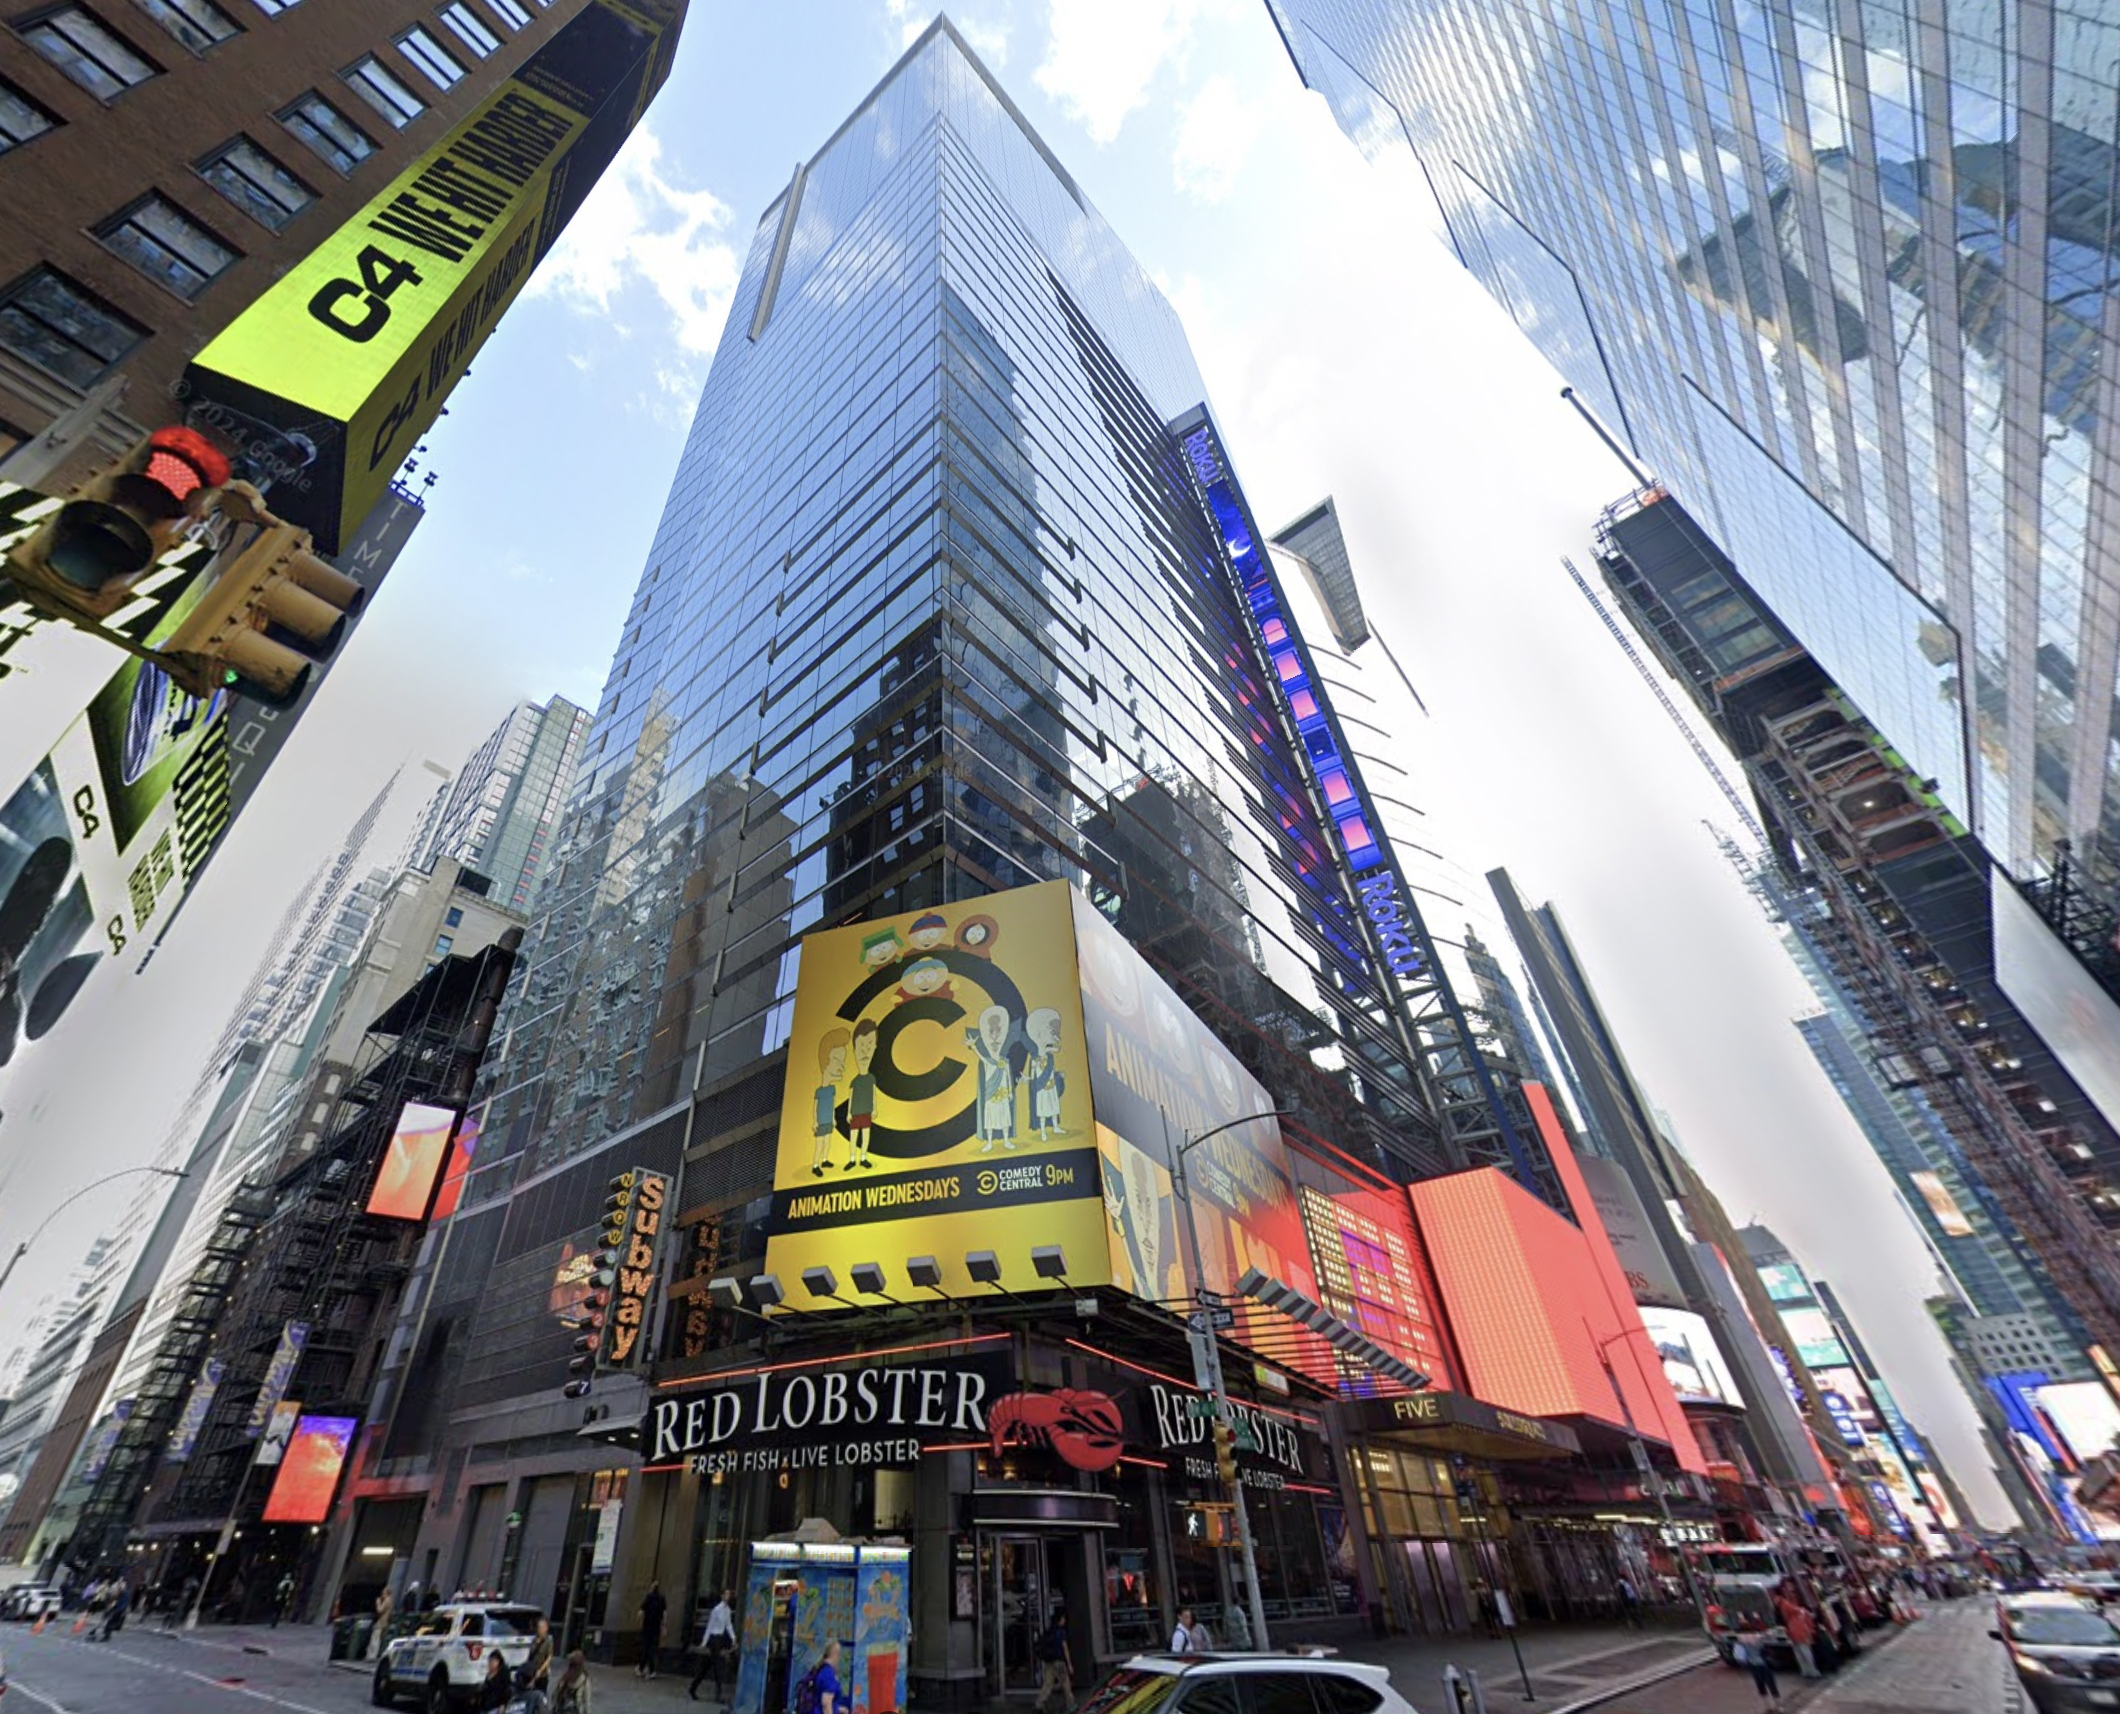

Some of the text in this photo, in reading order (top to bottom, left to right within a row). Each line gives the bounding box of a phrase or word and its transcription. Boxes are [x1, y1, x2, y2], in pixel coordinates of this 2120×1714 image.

[447, 92, 573, 187] HARDER
[410, 156, 514, 223] HIT
[367, 191, 485, 263] WE
[307, 244, 423, 343] C4
[369, 373, 422, 472] C4
[73, 784, 99, 839] C4
[107, 914, 126, 956] C4
[1356, 873, 1419, 975] ROKU
[788, 1176, 960, 1220] ANIMATION WEDNESDAYS
[999, 1165, 1042, 1181] COMEDY
[999, 1177, 1043, 1192] CENTRAL
[1045, 1164, 1074, 1186] 9PM
[610, 1176, 665, 1361] Subway
[651, 1368, 986, 1461] RED LOBSTER
[1150, 1384, 1205, 1448] RED
[1393, 1398, 1439, 1420] FIVE
[690, 1453, 738, 1474] FRESH
[743, 1451, 780, 1471] FISH
[792, 1446, 828, 1469] LIVE
[835, 1438, 919, 1464] LOBSTER
